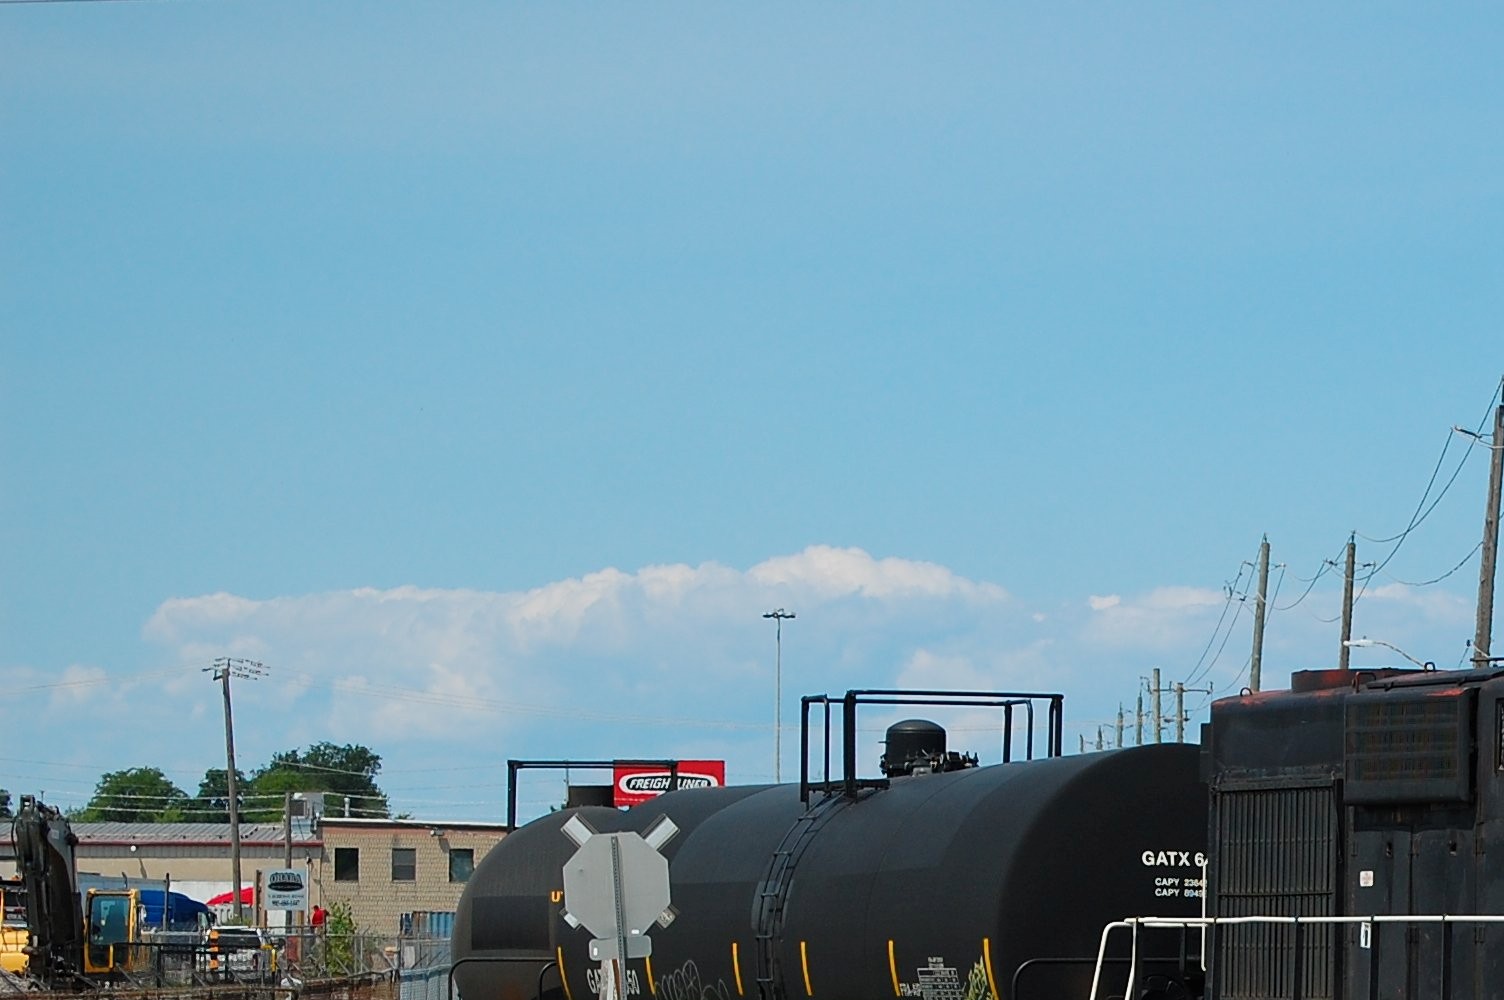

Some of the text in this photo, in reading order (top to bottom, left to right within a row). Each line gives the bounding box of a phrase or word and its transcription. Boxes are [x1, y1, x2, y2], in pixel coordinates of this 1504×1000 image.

[629, 777, 708, 791] FREIGHLINER
[1141, 850, 1191, 867] GATX
[1154, 877, 1180, 887] CAPY
[1154, 887, 1180, 897] CAPY
